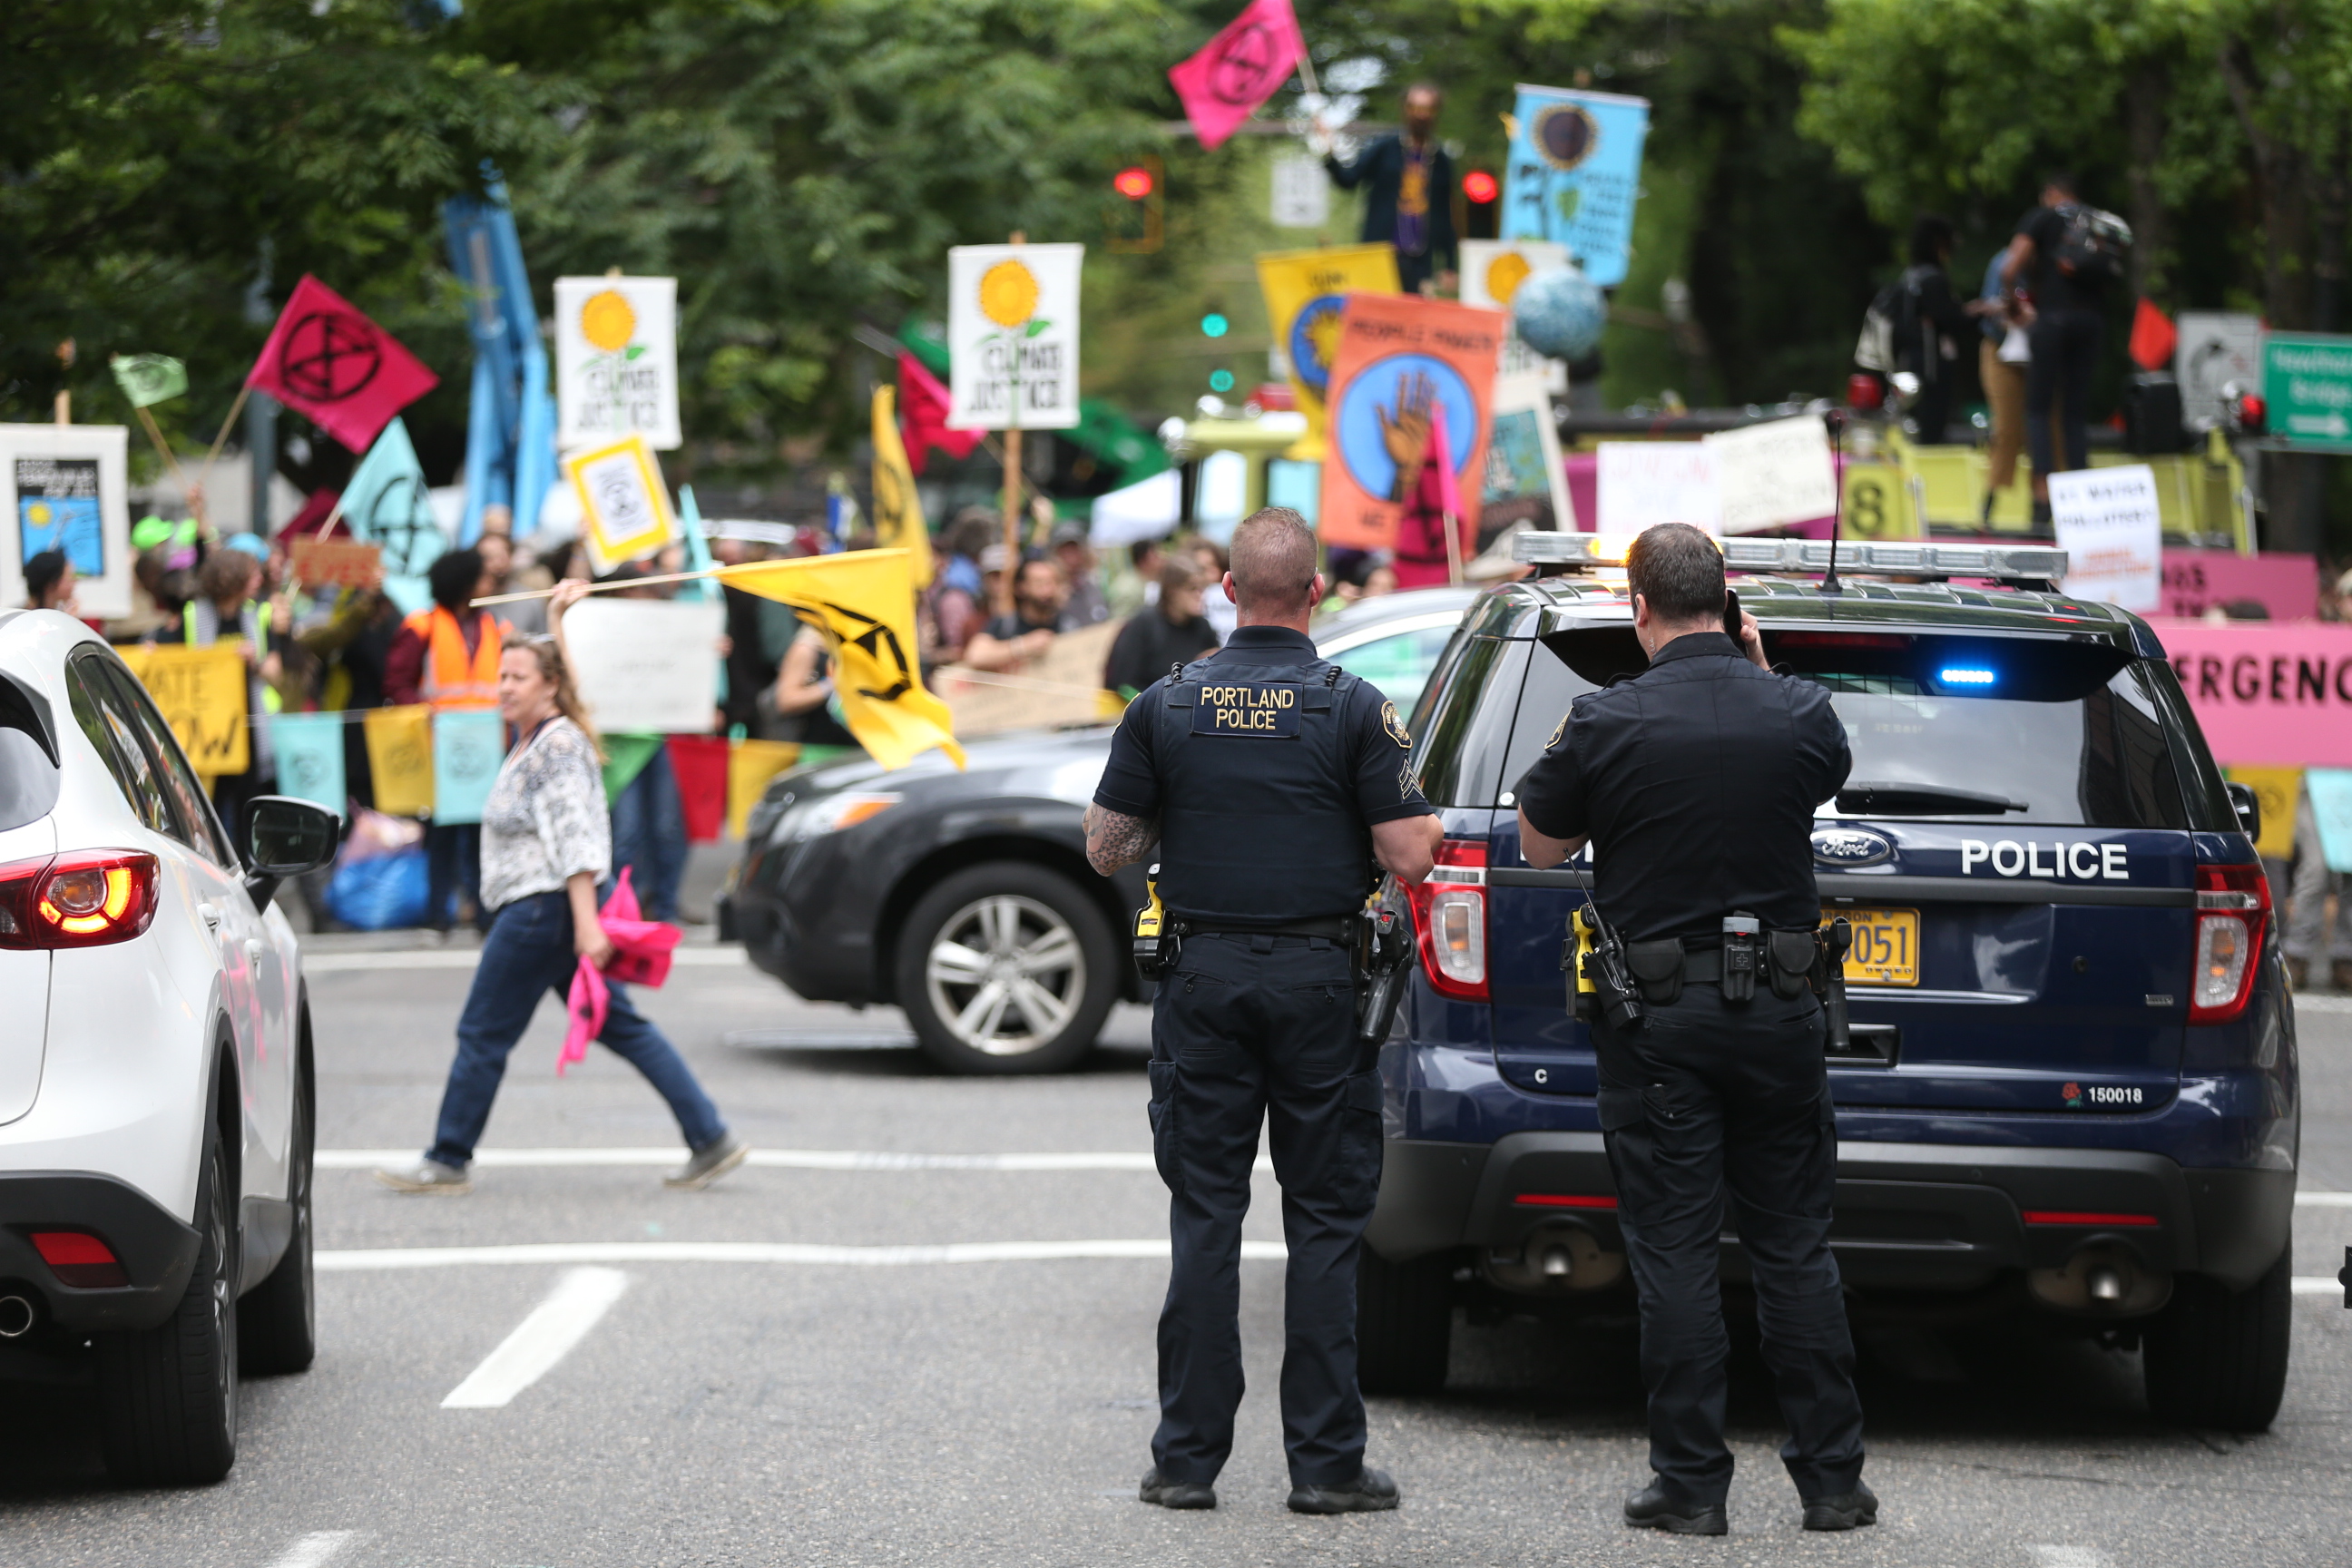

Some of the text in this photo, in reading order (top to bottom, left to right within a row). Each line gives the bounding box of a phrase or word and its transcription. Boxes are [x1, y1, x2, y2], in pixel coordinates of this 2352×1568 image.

[1350, 318, 1427, 343] PEOPLE
[1200, 686, 1294, 709] PORTLAND
[1216, 708, 1277, 730] POLICE
[1820, 834, 1872, 857] Ford
[1961, 838, 2130, 880] POLICE
[1821, 911, 1872, 922] REGON
[1534, 1068, 1548, 1084] C
[2088, 1087, 2142, 1103] 150018
